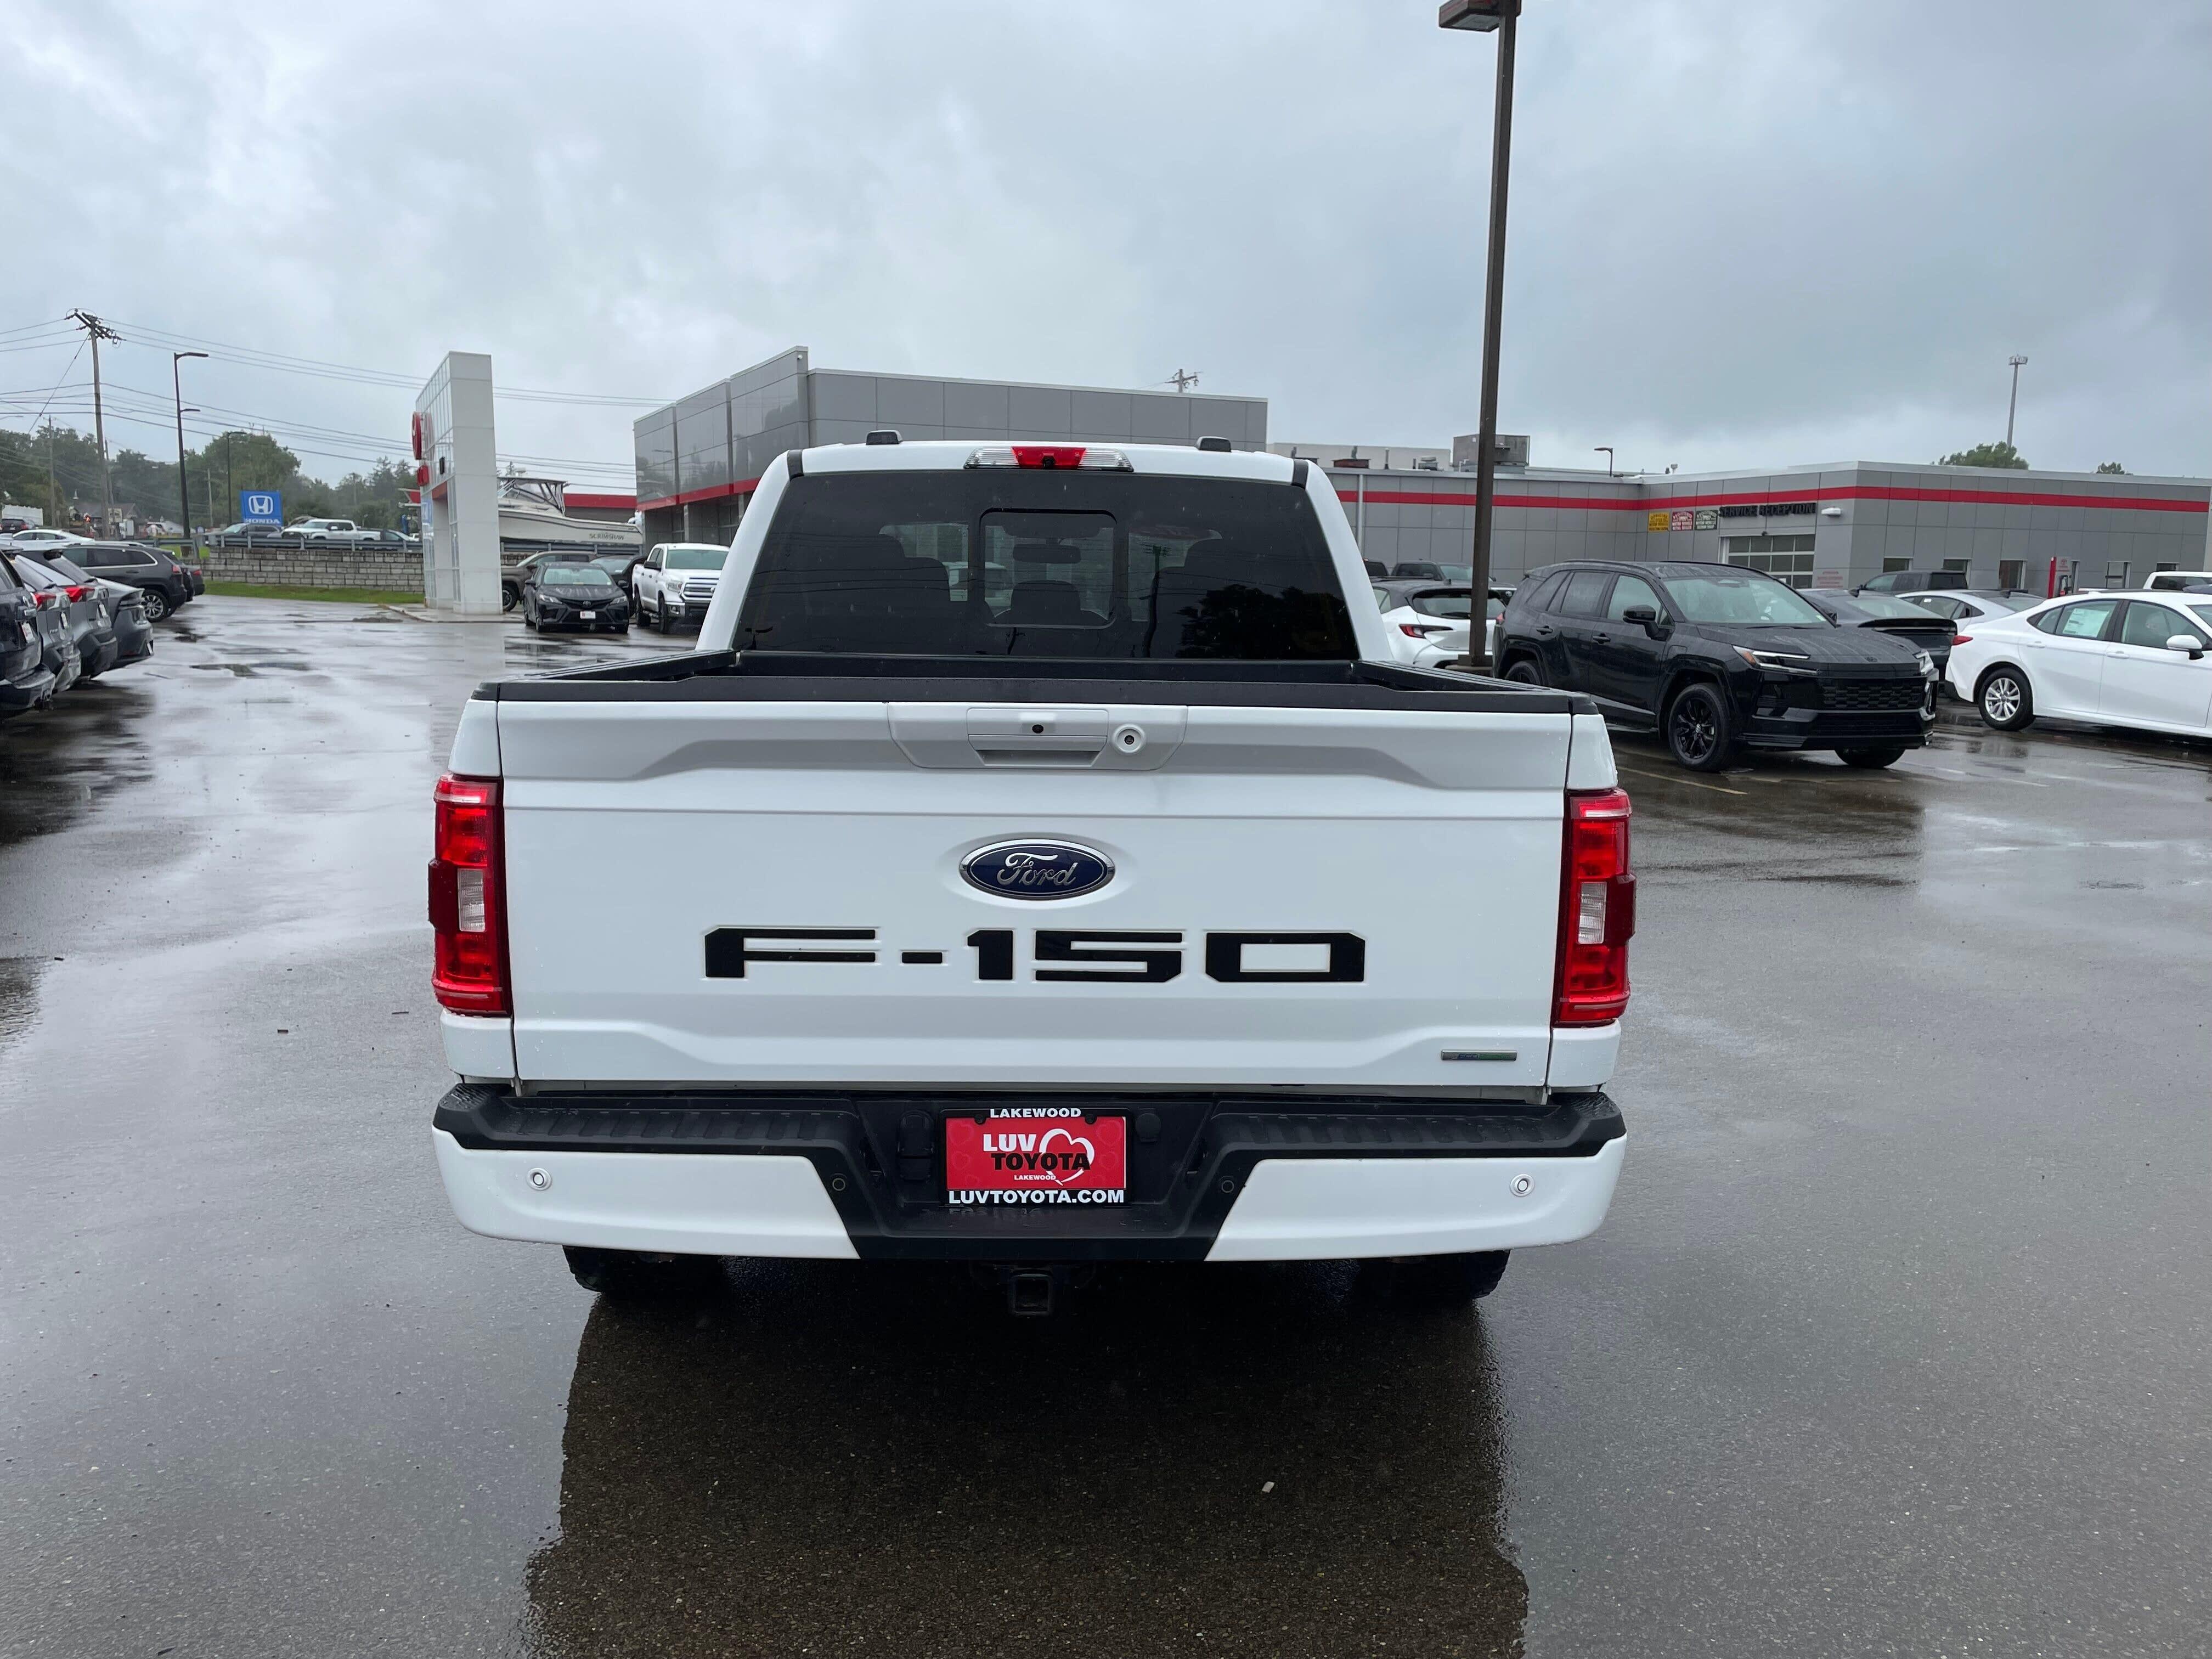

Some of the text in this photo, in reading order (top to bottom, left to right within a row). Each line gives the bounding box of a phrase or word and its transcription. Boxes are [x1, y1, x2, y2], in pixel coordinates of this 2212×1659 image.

[1719, 505, 1758, 517] SERVICE
[996, 853, 1079, 886] Ford
[704, 927, 1367, 984] F-150
[990, 1108, 1082, 1118] LAKEWOOD
[983, 1133, 1037, 1152] LUV
[990, 1153, 1091, 1171] TOYOTA
[949, 1189, 1125, 1204] LUVTOYOTA.COM
